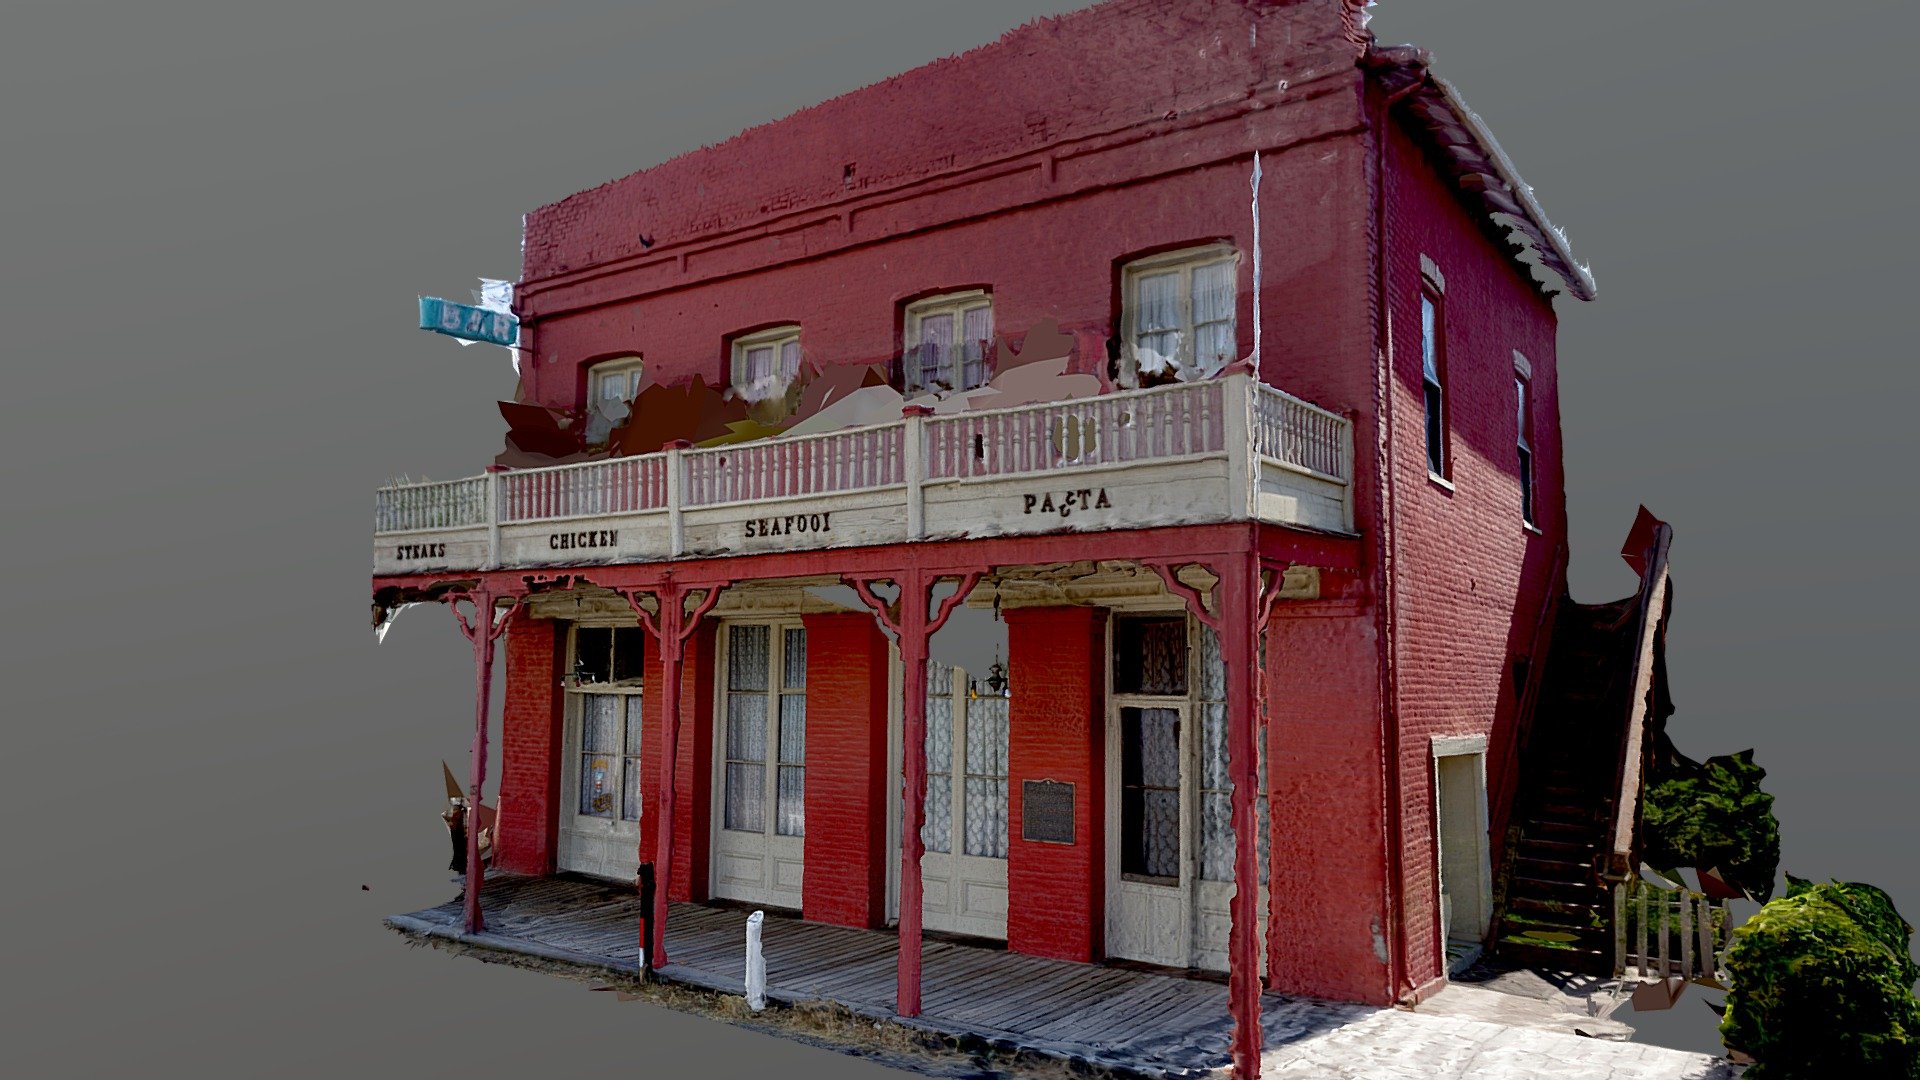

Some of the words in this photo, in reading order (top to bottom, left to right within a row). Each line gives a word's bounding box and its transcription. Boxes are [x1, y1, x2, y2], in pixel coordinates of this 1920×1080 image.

[442, 303, 510, 341] BAR
[550, 529, 618, 549] CHICKEN
[397, 543, 446, 560] STEAKS
